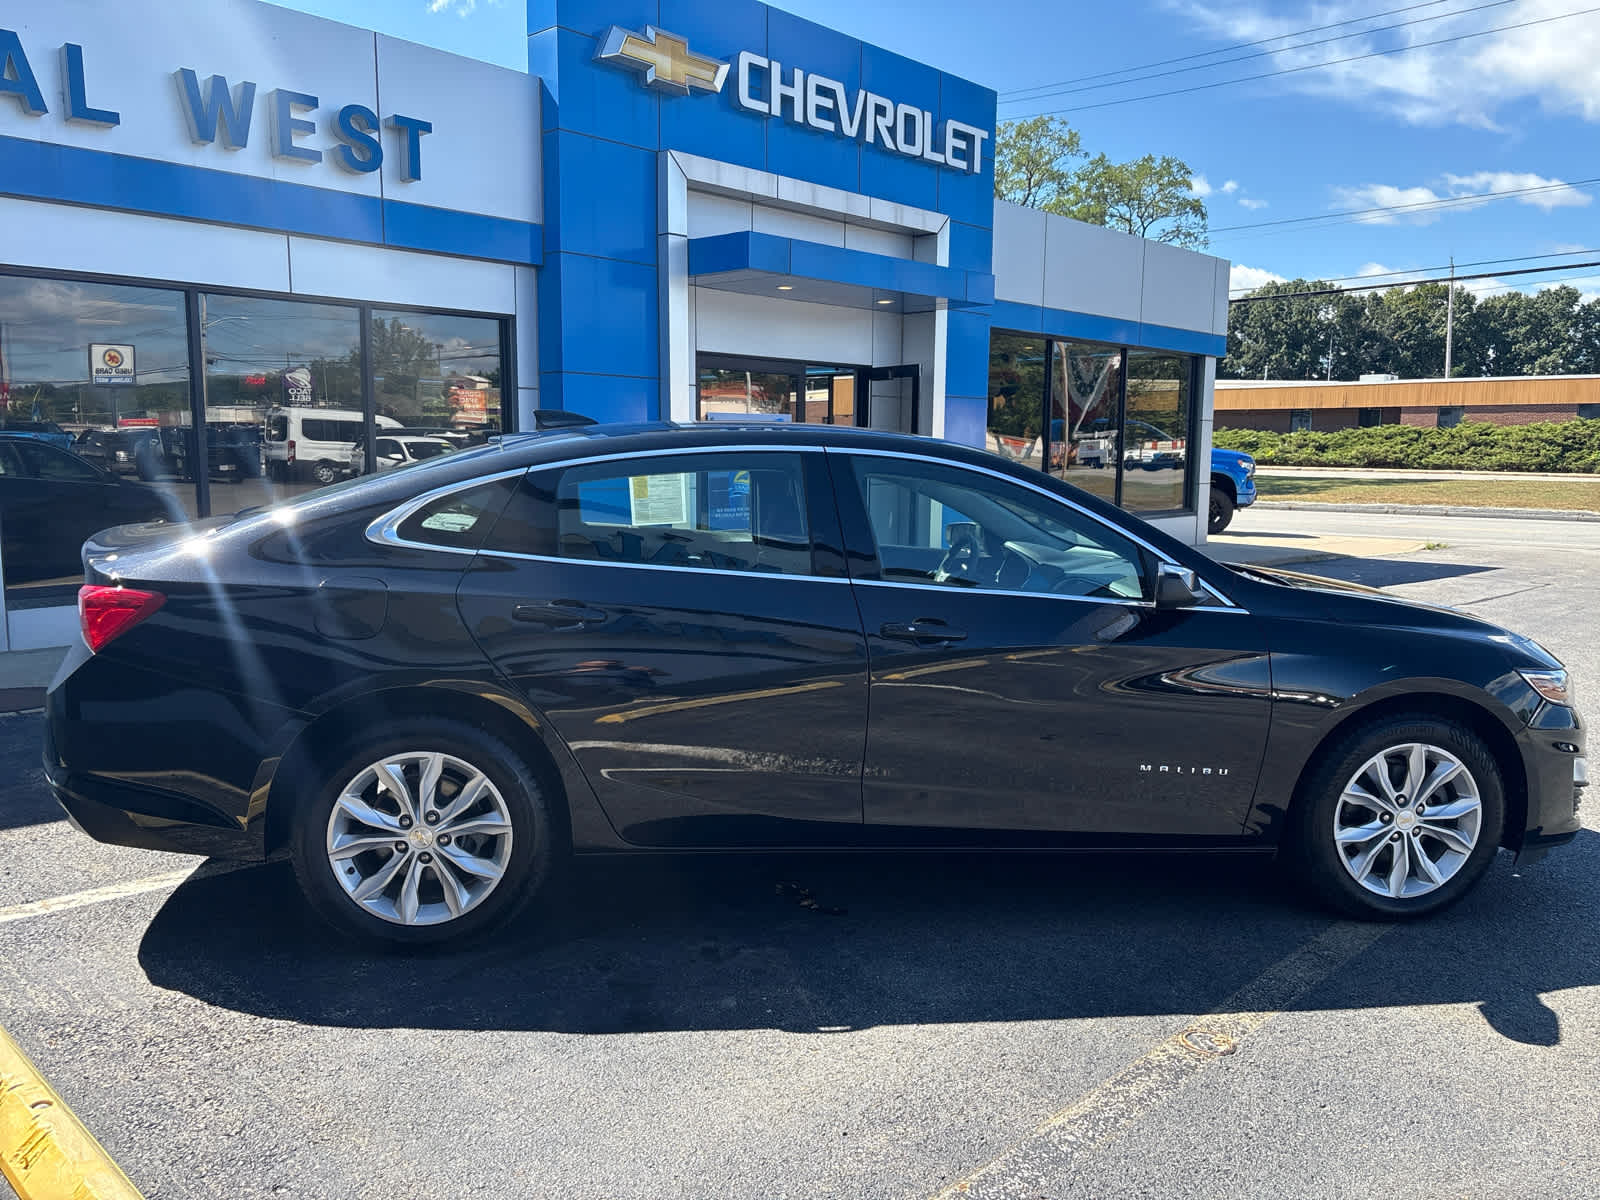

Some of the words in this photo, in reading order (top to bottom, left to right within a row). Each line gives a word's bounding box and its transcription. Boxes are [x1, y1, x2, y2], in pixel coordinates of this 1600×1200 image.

[172, 67, 433, 184] WEST
[737, 50, 989, 174] CHEVROLET
[1139, 764, 1229, 776] MALIBU
